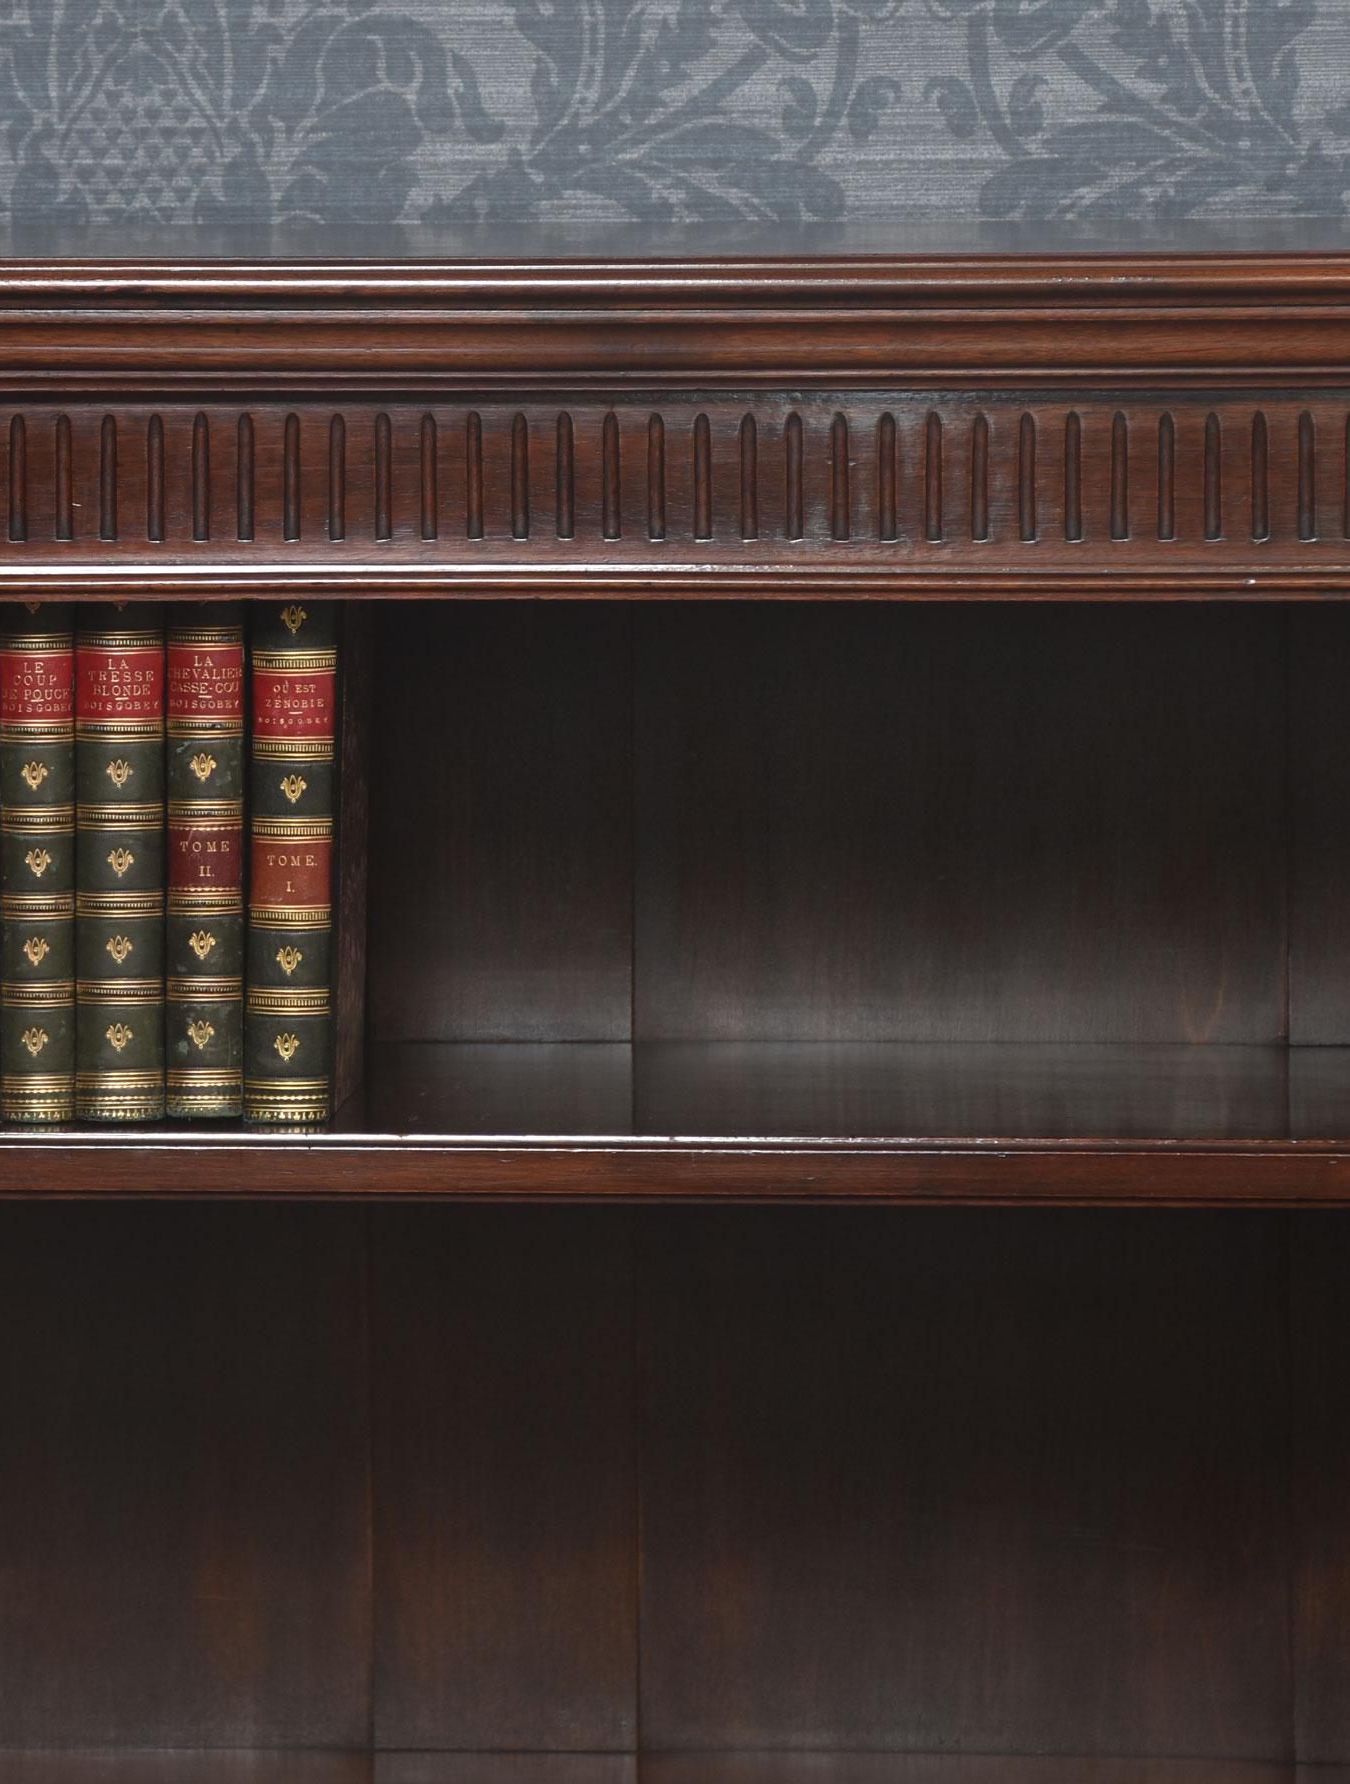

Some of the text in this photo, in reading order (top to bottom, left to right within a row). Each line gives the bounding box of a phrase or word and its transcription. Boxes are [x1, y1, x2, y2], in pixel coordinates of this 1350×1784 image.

[108, 658, 129, 670] LA
[194, 655, 213, 667] LA
[24, 662, 44, 673] LE
[13, 675, 57, 686] COUP
[88, 670, 154, 682] TRESSE
[93, 684, 151, 696] BLONDE
[295, 684, 316, 693] EST
[180, 840, 230, 852] TOME
[199, 865, 215, 877] II.
[286, 881, 296, 892] I.
